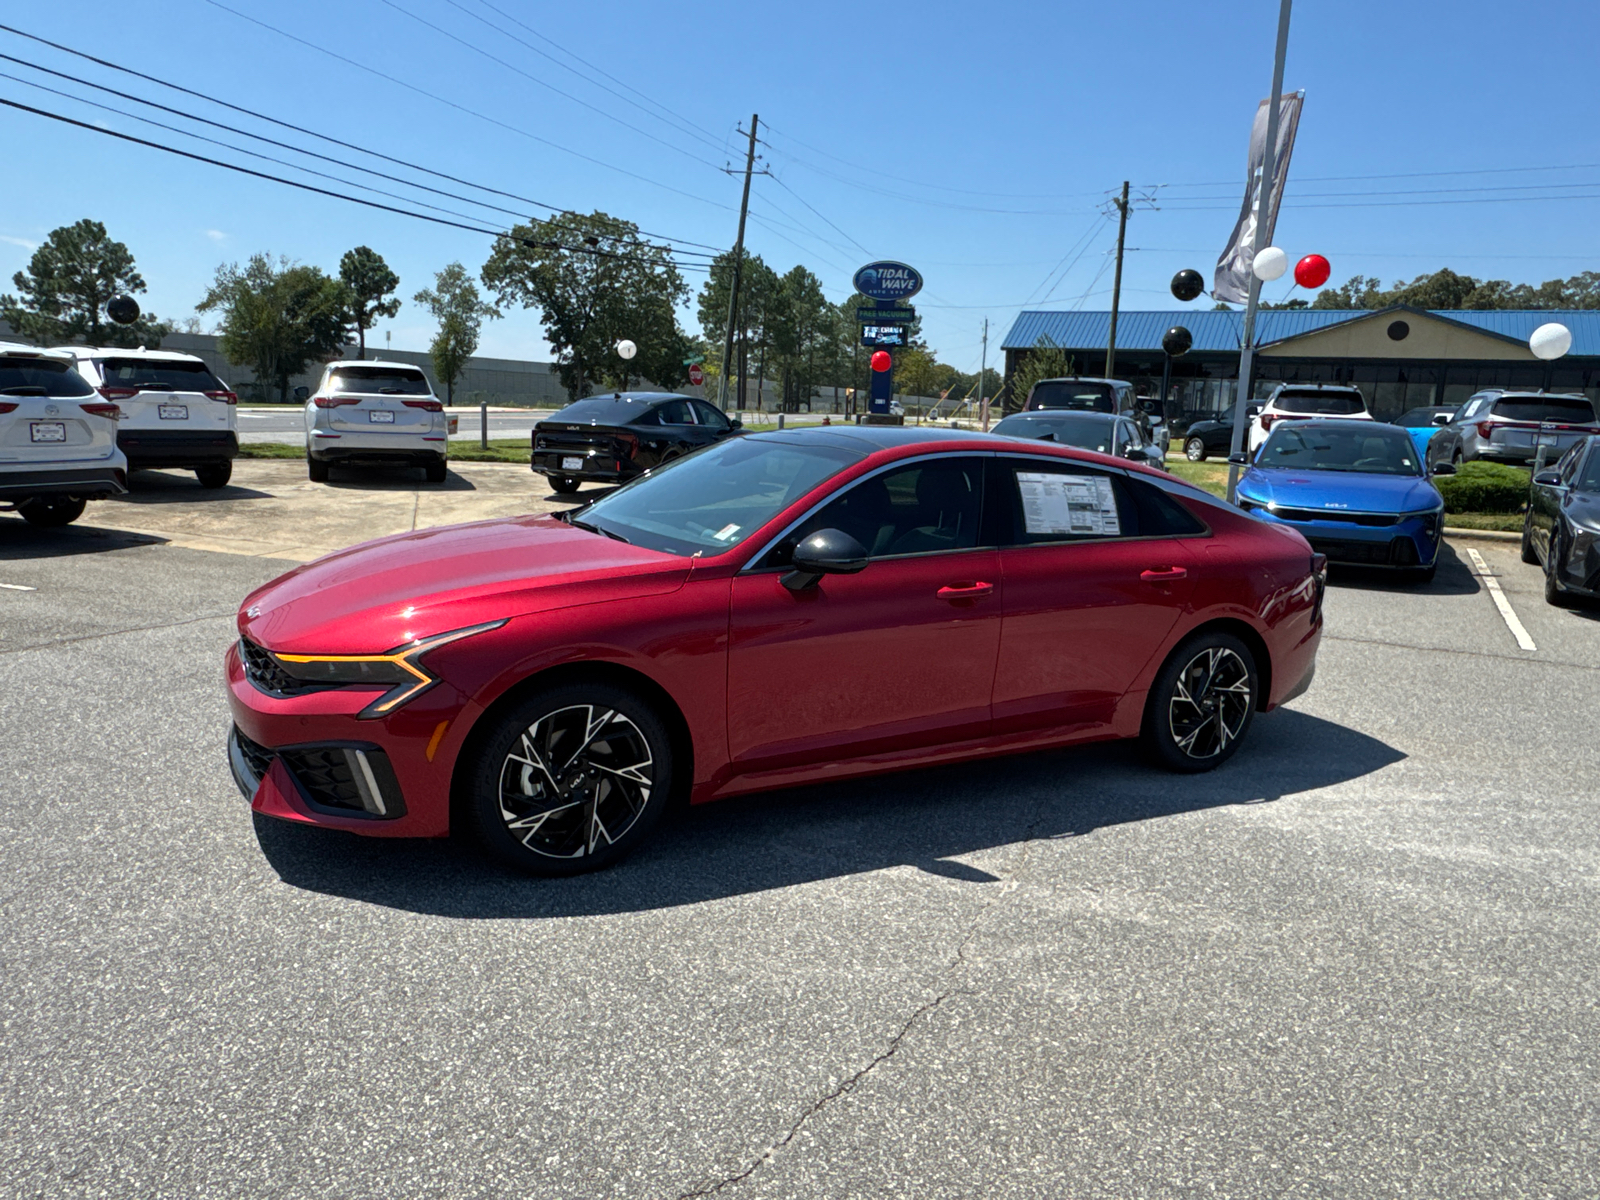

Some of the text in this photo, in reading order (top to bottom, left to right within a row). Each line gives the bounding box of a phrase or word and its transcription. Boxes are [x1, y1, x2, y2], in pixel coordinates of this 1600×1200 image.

[877, 268, 909, 279] TIDAL
[881, 279, 915, 289] WAVE
[690, 371, 703, 380] STOP
